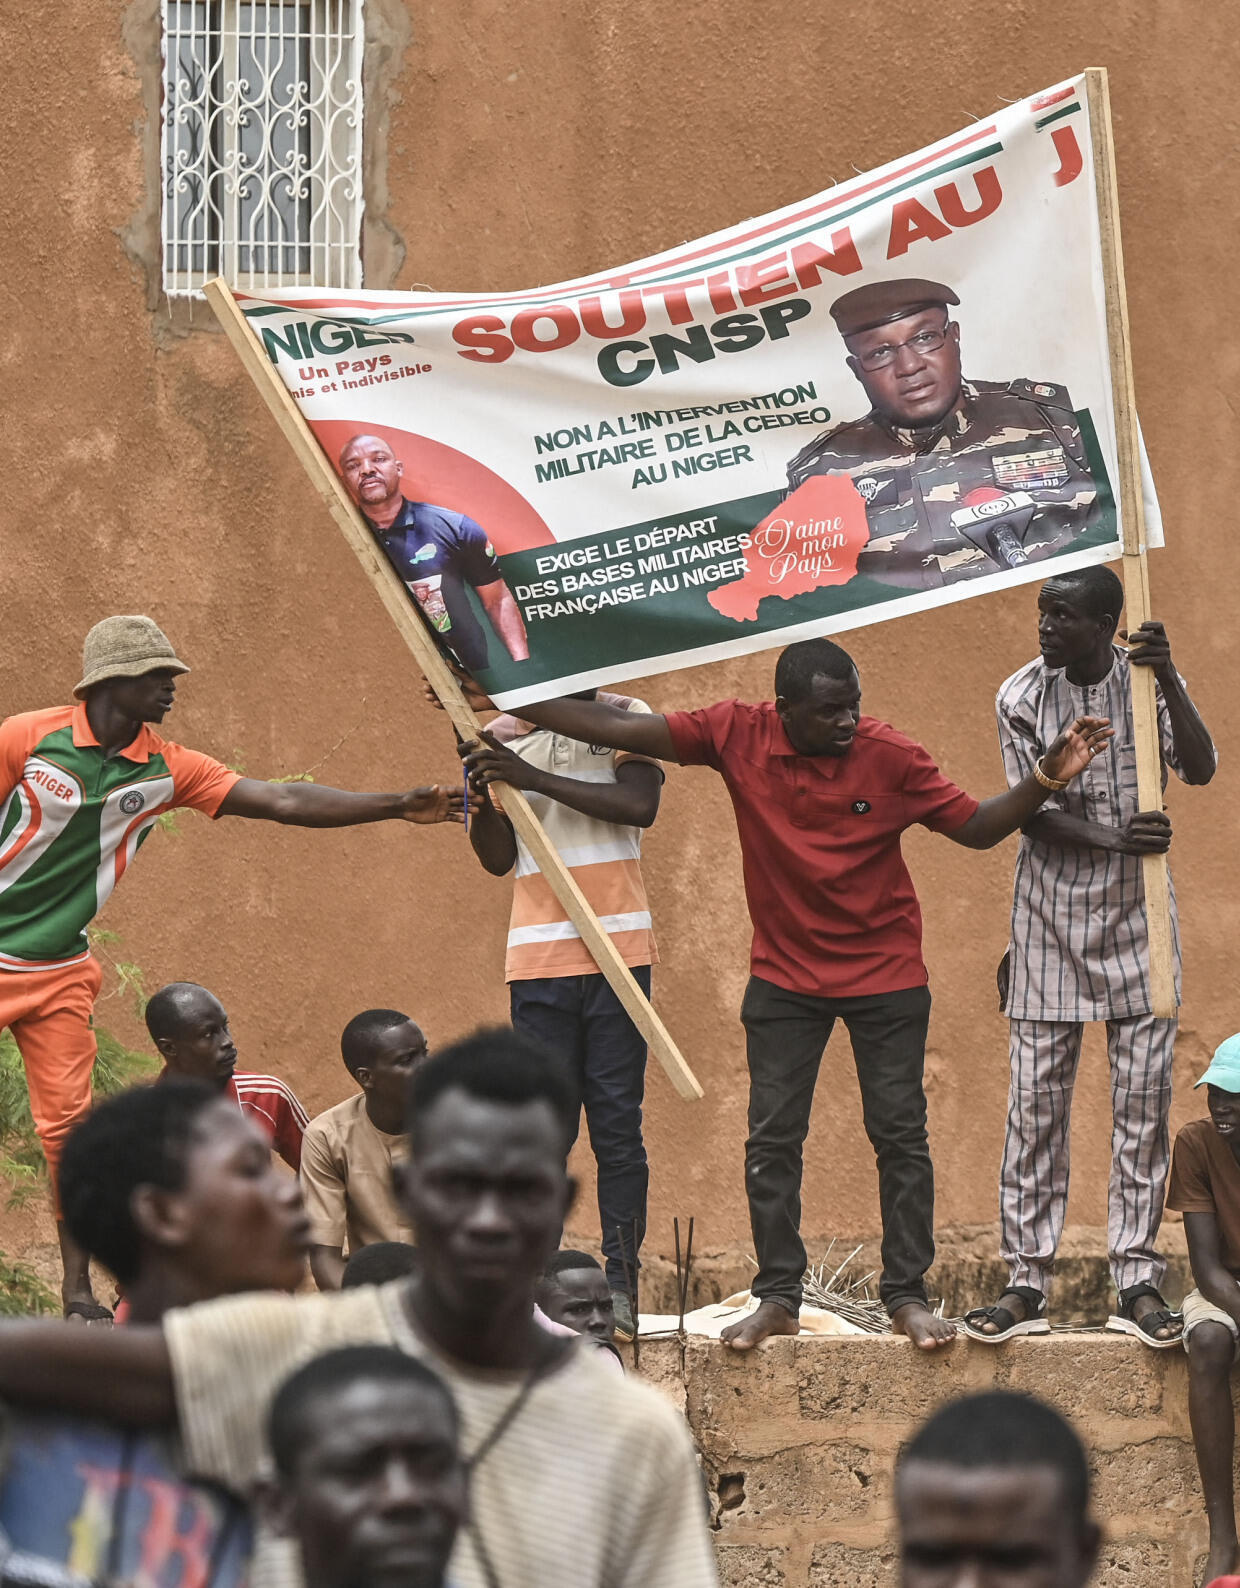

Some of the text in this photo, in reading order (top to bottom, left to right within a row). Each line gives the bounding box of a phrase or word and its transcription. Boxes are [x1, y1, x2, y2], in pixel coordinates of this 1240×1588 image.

[452, 225, 864, 364] SOUTIEN
[887, 166, 1003, 260] AU
[597, 298, 812, 387] CNSP
[290, 363, 433, 400] nis et indivisible
[299, 354, 393, 381] Un Pays
[534, 424, 593, 454] NON
[597, 420, 618, 441] A
[534, 407, 831, 483] MILITAIRE DE LA CEDEO
[631, 444, 754, 489] AU NIGER
[514, 533, 753, 601] DES BASES MILITAIRES
[535, 516, 718, 575] EXIGE LE DÉPART
[802, 533, 848, 556] mon
[524, 557, 751, 621] FRANÇAISE AU NIGER
[768, 551, 842, 584] Pays
[32, 769, 75, 802] NIGER
